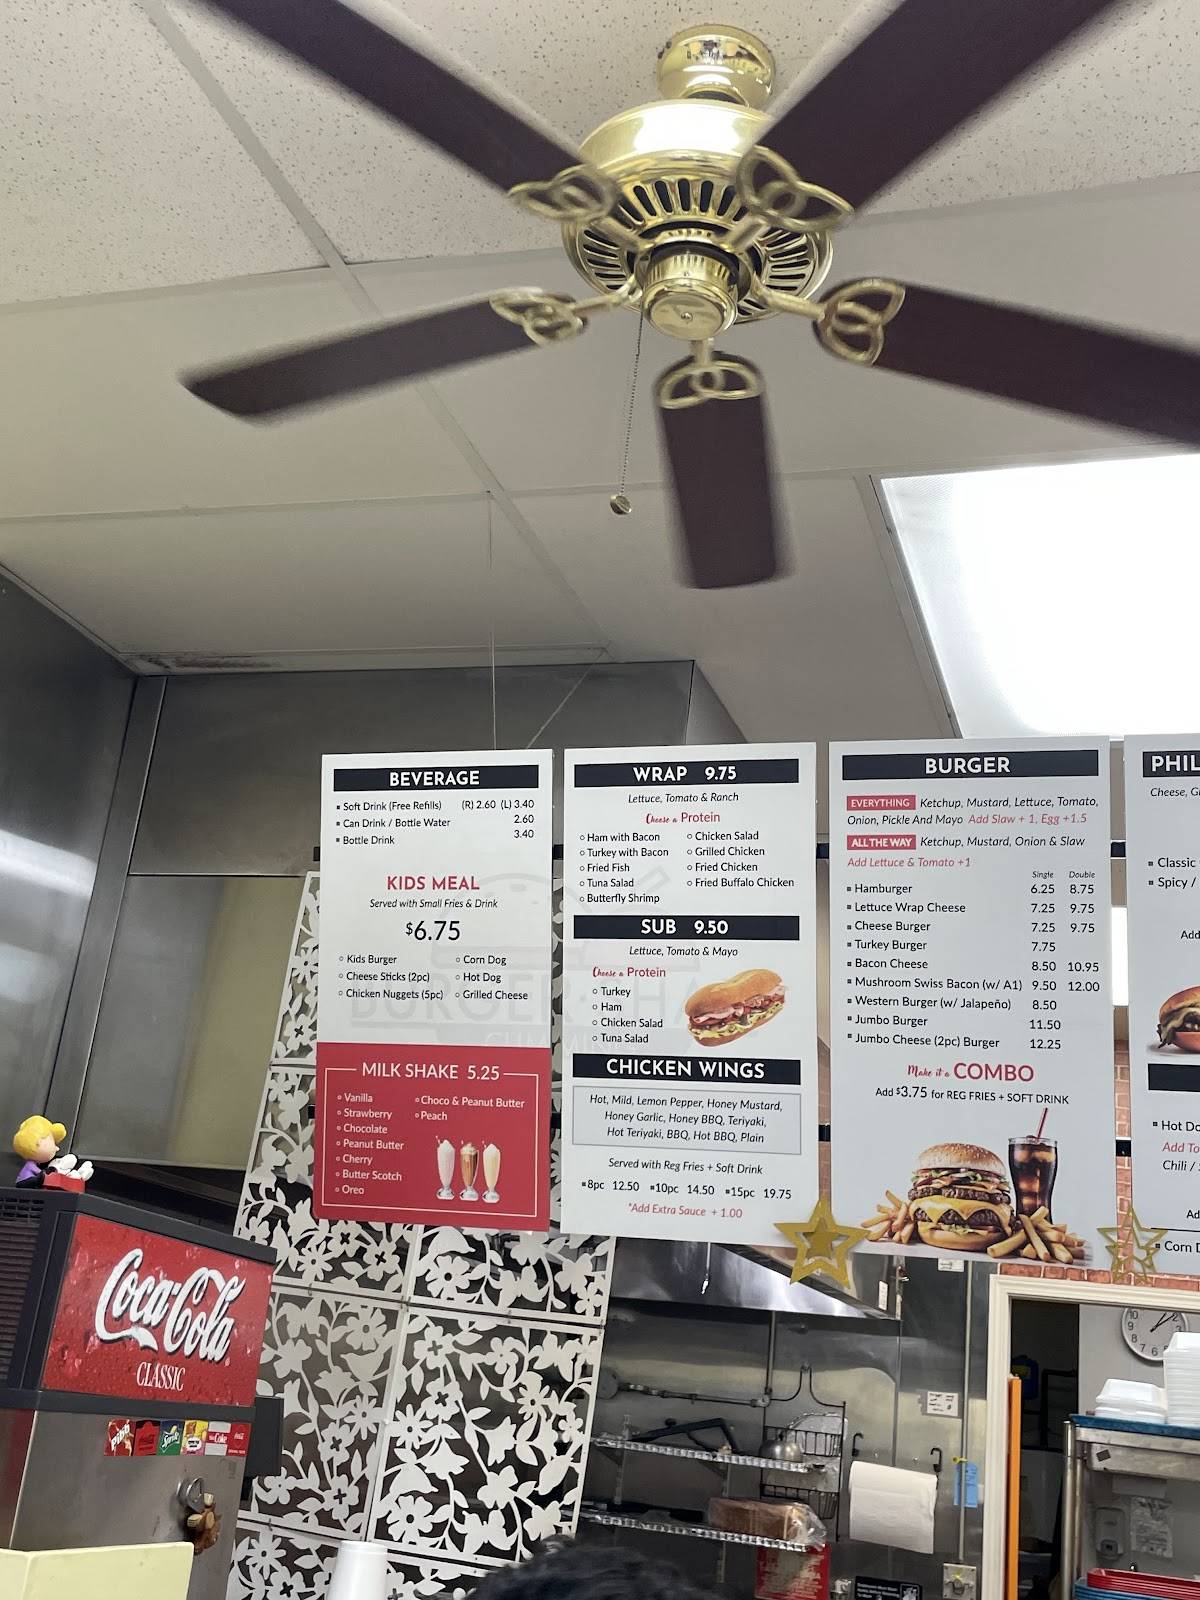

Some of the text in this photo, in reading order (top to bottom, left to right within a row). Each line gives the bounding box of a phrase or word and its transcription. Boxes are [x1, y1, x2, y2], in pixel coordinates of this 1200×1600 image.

[926, 757, 1010, 773] BURGER
[390, 771, 479, 786] BEVERAGE
[633, 766, 736, 781] WRAP 9.75
[1151, 788, 1187, 796] Cheese,
[629, 793, 738, 803] Lettuce, Tomato & Ranch
[851, 797, 1098, 808] EVERYTHING Ketchup, Mustard, Lettuce, Tomato,
[364, 802, 386, 810] Drink
[389, 802, 413, 810] (Free
[414, 801, 441, 809] Refills)
[462, 801, 473, 810] (R)
[477, 800, 496, 809] 2.60
[501, 800, 511, 810] (L)
[515, 800, 534, 808] 3.40
[343, 830, 534, 844] Bottle Drink 3.40
[610, 833, 629, 841] with
[633, 833, 659, 841] Bacon
[695, 831, 758, 840] Chicken Salad
[695, 847, 764, 856] Grilled Chicken
[588, 863, 629, 872] Fried Fish
[1158, 858, 1195, 867] Classic
[1032, 871, 1053, 879] Single
[388, 876, 480, 890] KIDS MEAL
[587, 879, 634, 887] Tuna Salad
[1158, 877, 1187, 889] Spicy
[855, 884, 1094, 895] Hamburger 6.25 8.75
[588, 894, 659, 903] Butterfly Shrimp
[406, 921, 460, 940] $6.75
[641, 919, 728, 934] SUB 9.50
[855, 921, 1094, 932] Cheese Burger 7.25 9.75
[855, 940, 1055, 951] Turkey Burger 7.75
[347, 955, 397, 965] Kids Burger
[464, 955, 506, 966] Corn Dog
[856, 958, 1098, 972] Bacon Cheese 8.50 10.95
[347, 972, 429, 982] Cheese Sticks (2pc)
[464, 973, 501, 983] Hot Dog
[856, 977, 1099, 991] Mushroom Swiss Bacon (w/ A1) 9.50 12.00
[346, 989, 443, 1000] Chicken Nuggets (5pc)
[463, 990, 528, 999] Grilled Cheese
[601, 987, 631, 996] Turkey
[602, 1003, 621, 1011] Ham
[855, 1015, 1061, 1029] Jumbo Burger 11.50
[856, 1034, 1060, 1049] Jumbo Cheese (2pc) Burger 12.25
[363, 1063, 499, 1080] MILK SHAKE 5.25
[607, 1059, 764, 1078] CHICKEN WINGS
[954, 1063, 1034, 1082] COMBO
[344, 1093, 372, 1102] Vanilla
[876, 1088, 893, 1096] Add
[896, 1086, 927, 1098] $3.75
[932, 1090, 944, 1098] for
[947, 1091, 966, 1099] REG
[969, 1092, 995, 1101] FRIES
[1008, 1093, 1033, 1102] SOFT
[1036, 1095, 1069, 1104] DRINK
[420, 1096, 525, 1108] Choco & Peanut Butter
[590, 1095, 782, 1111] Hot, Mild, Lemon Pepper, Honey Mustard,
[344, 1108, 392, 1119] Strawberry
[420, 1111, 447, 1120] Peach
[343, 1124, 387, 1133] Chocolate
[1162, 1121, 1182, 1130] Hot
[1162, 1142, 1184, 1152] Add
[343, 1154, 373, 1165] Cherry
[1163, 1160, 1187, 1170] Chili
[342, 1185, 364, 1194] Oreo
[588, 1180, 791, 1199] 8pc 12.50 10pc 14.50 15pc 19.75
[652, 1204, 676, 1214] Extra
[679, 1206, 706, 1216] Sauce
[721, 1208, 742, 1218] 1.00
[1165, 1241, 1191, 1252] Corn
[95, 1248, 245, 1361] Coca-Cola
[1128, 1322, 1133, 1330] 9
[1132, 1334, 1137, 1343] 8
[1140, 1344, 1145, 1352] 7
[1152, 1347, 1158, 1356] 6
[137, 1362, 185, 1391] CLASSIC
